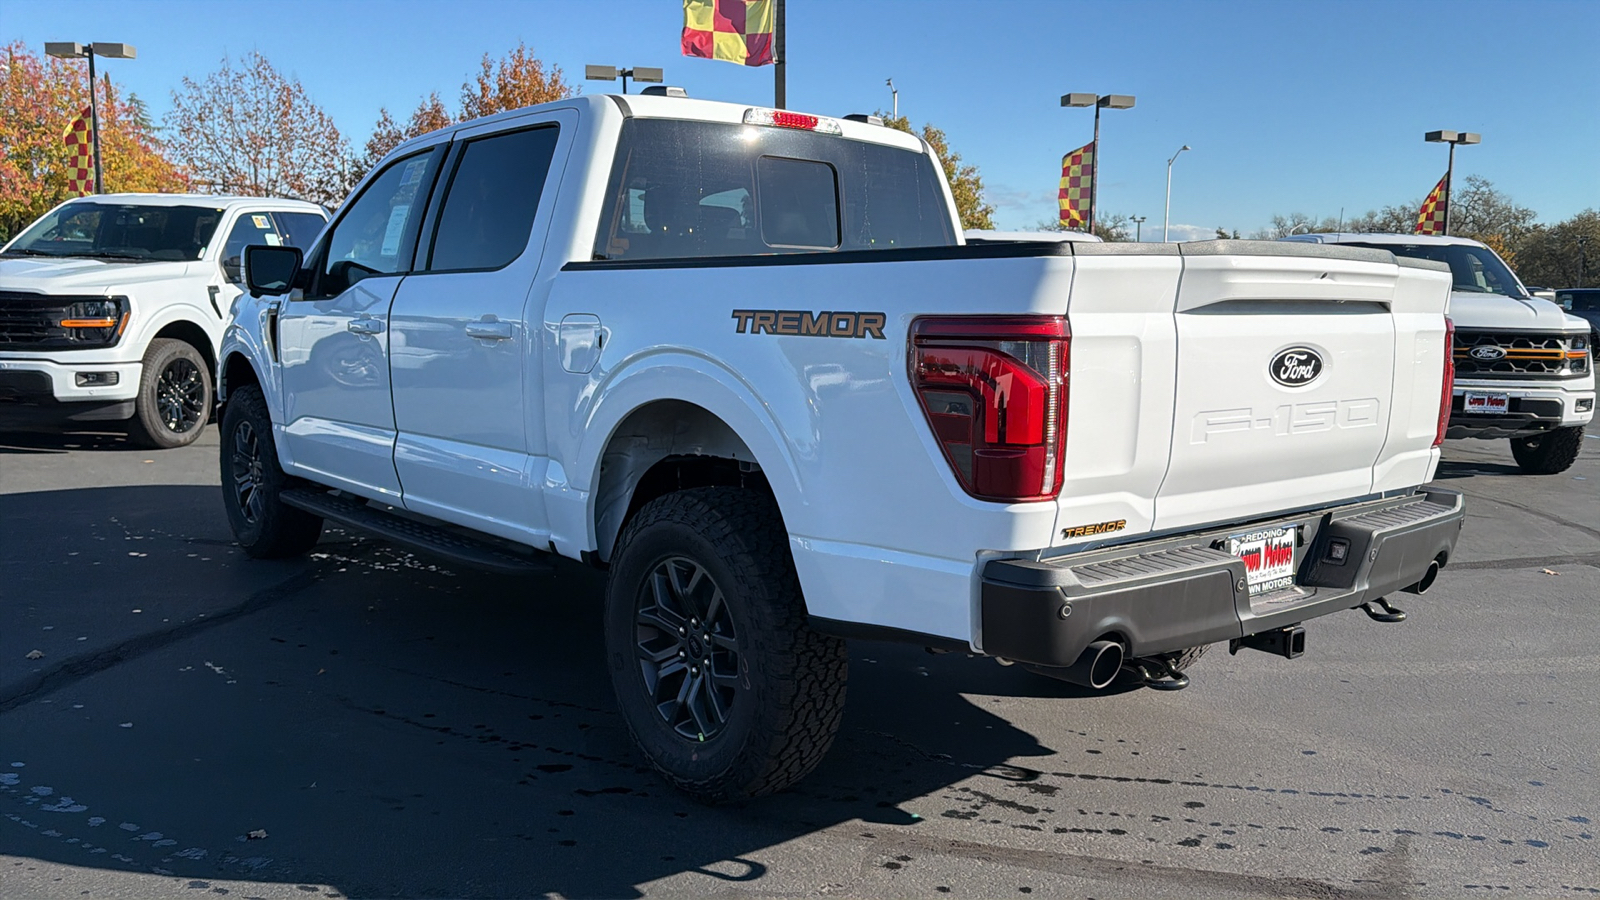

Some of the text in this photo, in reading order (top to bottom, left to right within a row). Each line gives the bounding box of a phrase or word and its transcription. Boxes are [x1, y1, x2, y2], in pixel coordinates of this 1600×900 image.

[731, 309, 887, 340] TREMOR
[1476, 349, 1498, 358] Ford
[1280, 353, 1316, 379] Ford
[1189, 397, 1380, 445] F-150
[1061, 519, 1126, 540] TREMOR
[1246, 529, 1282, 542] REDDING
[1263, 539, 1293, 570] Motors
[1262, 577, 1292, 590] MOTORS
